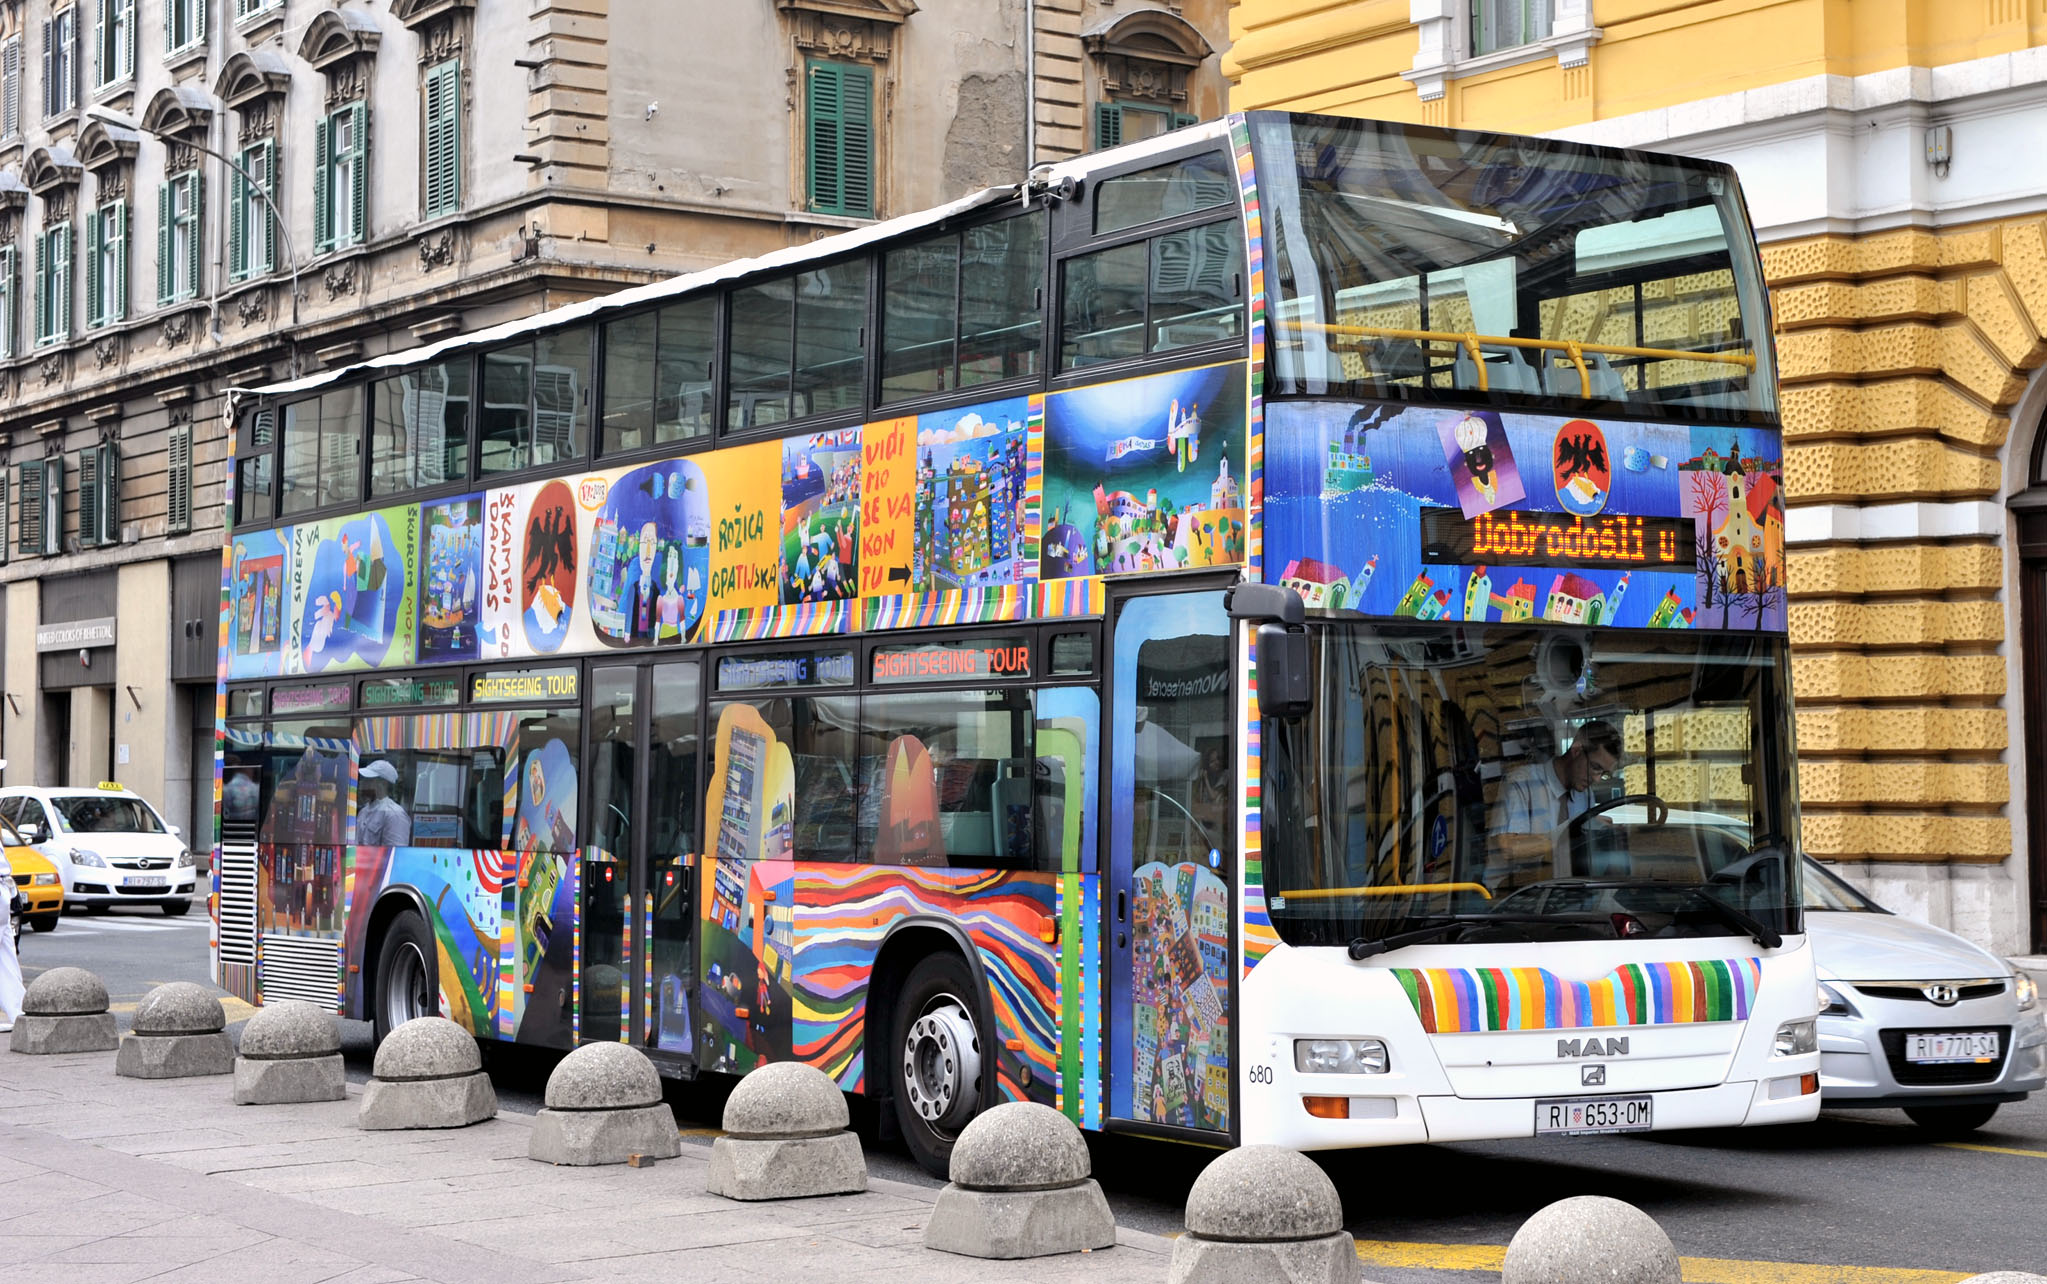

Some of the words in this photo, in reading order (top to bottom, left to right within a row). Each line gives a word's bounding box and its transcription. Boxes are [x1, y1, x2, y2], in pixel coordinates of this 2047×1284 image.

[863, 496, 880, 528] SE
[887, 491, 911, 521] VA
[306, 524, 320, 547] VA
[719, 502, 764, 553] ROŽICA
[1473, 511, 1645, 560] Dobrodošli
[406, 507, 418, 588] ŠKUROM
[487, 502, 499, 612] DANAS
[500, 492, 515, 604] ŠKAMPI
[863, 528, 895, 560] KON
[294, 527, 303, 603] SIRENA
[863, 565, 884, 592] TU
[712, 562, 776, 599] OPATIJSKA
[501, 622, 510, 657] OD
[720, 657, 807, 685] SIGHTSEEING
[814, 655, 853, 679] TOUR
[874, 649, 976, 677] SIGHTSEEING
[984, 647, 1029, 672] TOUR
[272, 688, 324, 709] SIGHTSEEING
[328, 686, 350, 704] TOUR
[365, 684, 425, 705] SIGHTSEEING
[429, 681, 456, 700] TOUR
[475, 676, 542, 698] SIGHTSEEING
[547, 675, 577, 695] TOUR
[1558, 1037, 1629, 1057] MAN
[1917, 1038, 1933, 1056] RI
[1947, 1036, 1996, 1056] 770-SA
[1249, 1065, 1273, 1085] 680
[1550, 1105, 1568, 1128] RI
